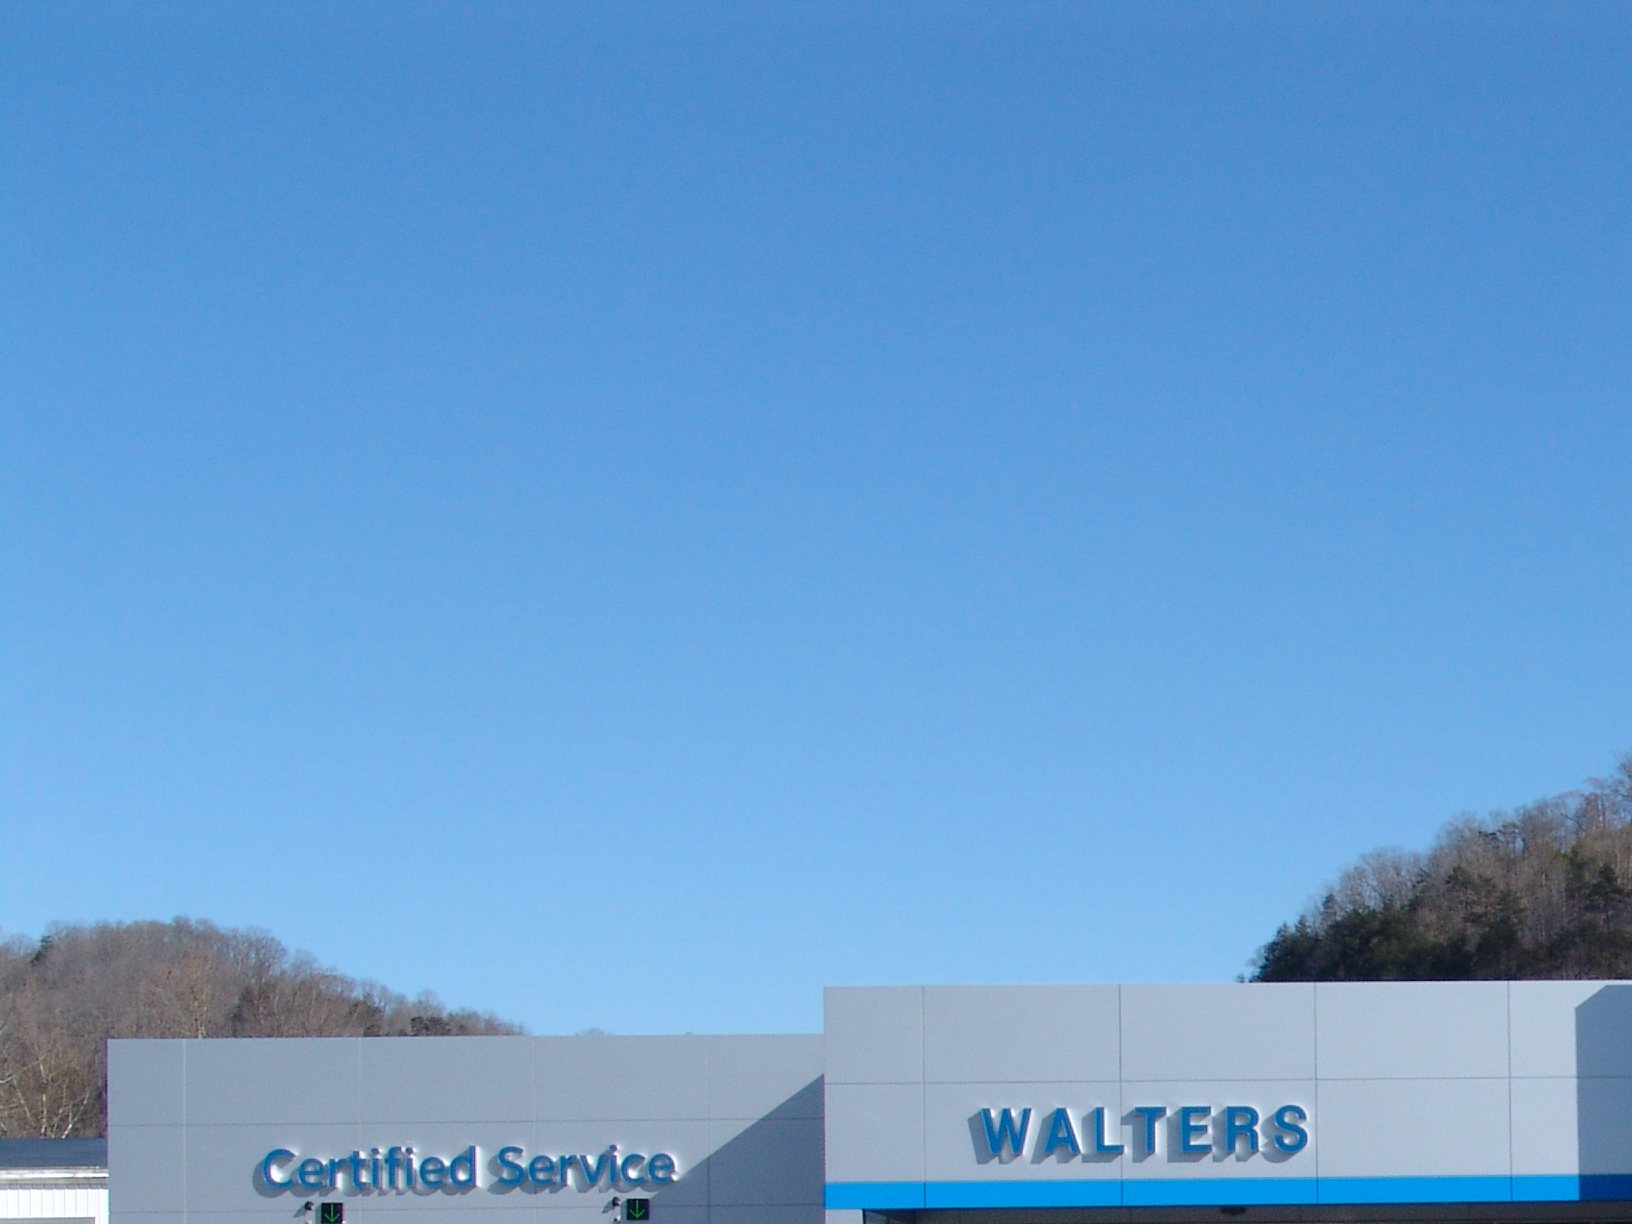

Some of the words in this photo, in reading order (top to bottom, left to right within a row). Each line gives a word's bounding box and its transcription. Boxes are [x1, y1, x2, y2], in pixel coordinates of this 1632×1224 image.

[980, 1105, 1308, 1154] WALTERS
[262, 1145, 481, 1189] Certified
[498, 1144, 678, 1187] Service
